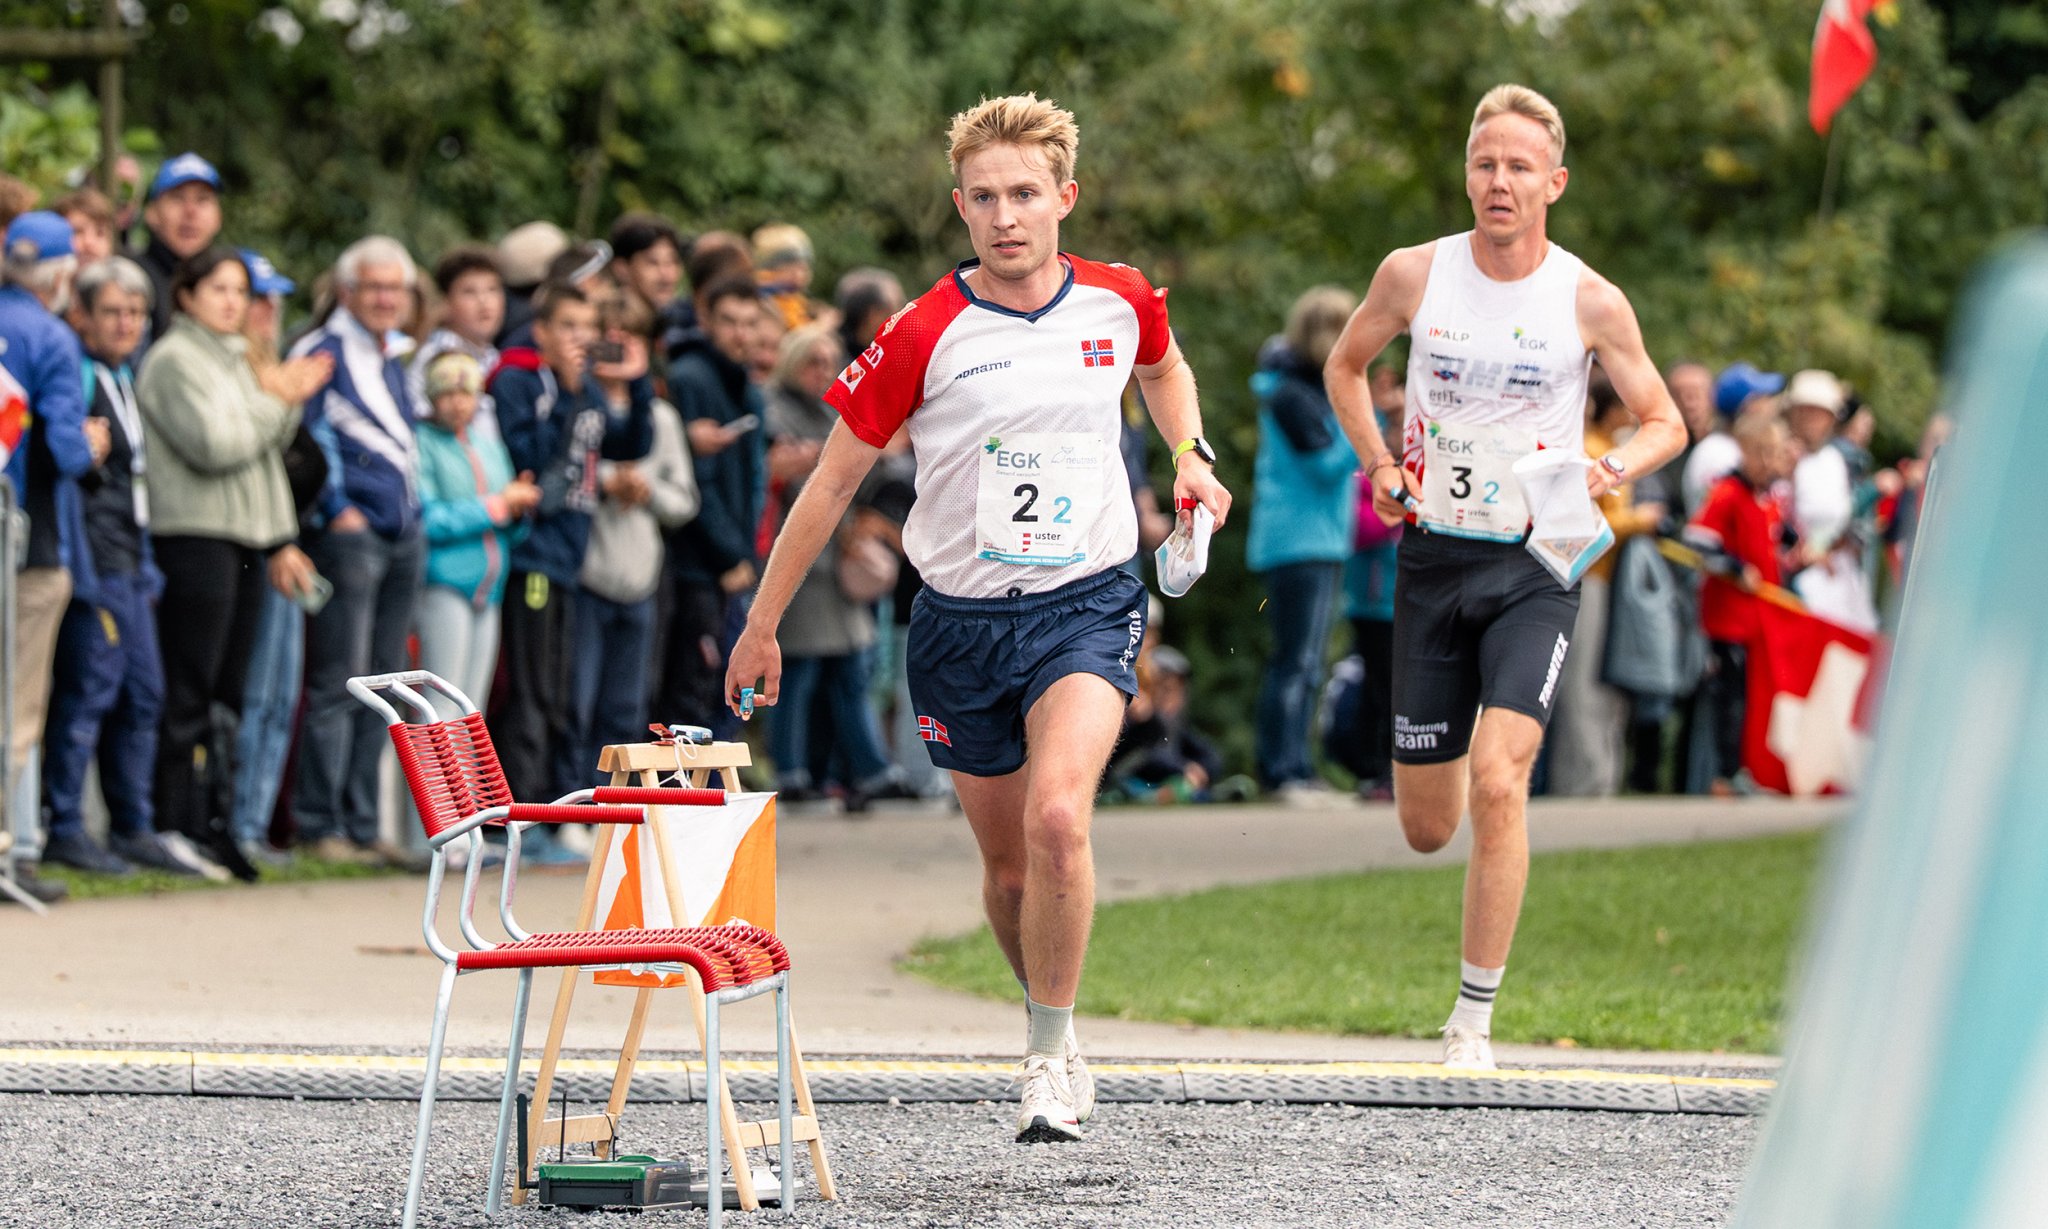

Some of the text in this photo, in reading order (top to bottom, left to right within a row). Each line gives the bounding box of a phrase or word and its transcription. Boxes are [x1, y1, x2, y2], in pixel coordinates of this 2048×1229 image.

[1428, 327, 1470, 341] INALP
[1519, 338, 1548, 351] EGK
[1436, 436, 1474, 455] EGK
[996, 450, 1041, 469] EGK
[1449, 466, 1499, 504] 3 2
[1012, 483, 1072, 524] 2 2
[1035, 533, 1062, 541] uster
